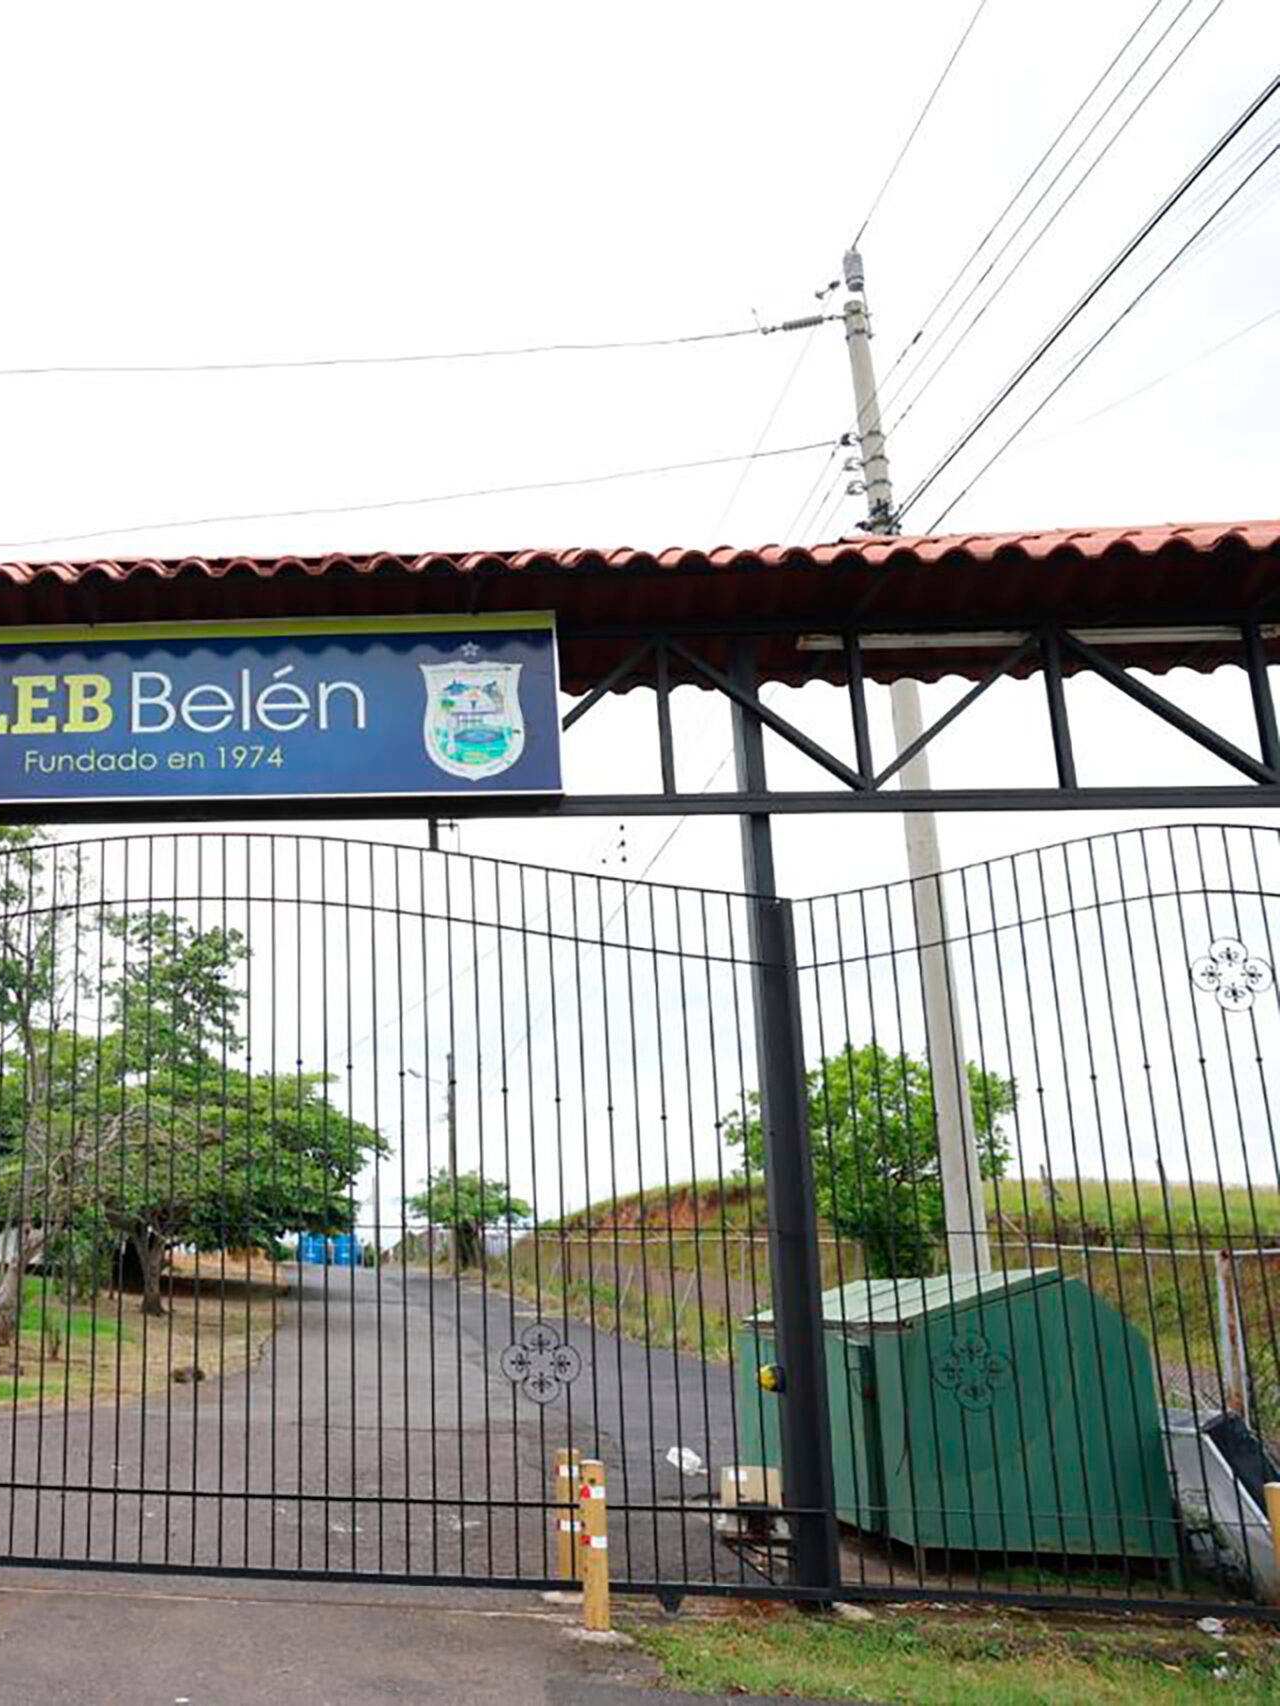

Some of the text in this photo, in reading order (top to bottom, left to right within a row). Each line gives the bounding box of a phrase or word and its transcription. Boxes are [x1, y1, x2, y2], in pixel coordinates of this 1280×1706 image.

[132, 665, 366, 733] Belén
[25, 746, 284, 773] Fundado en 1974
